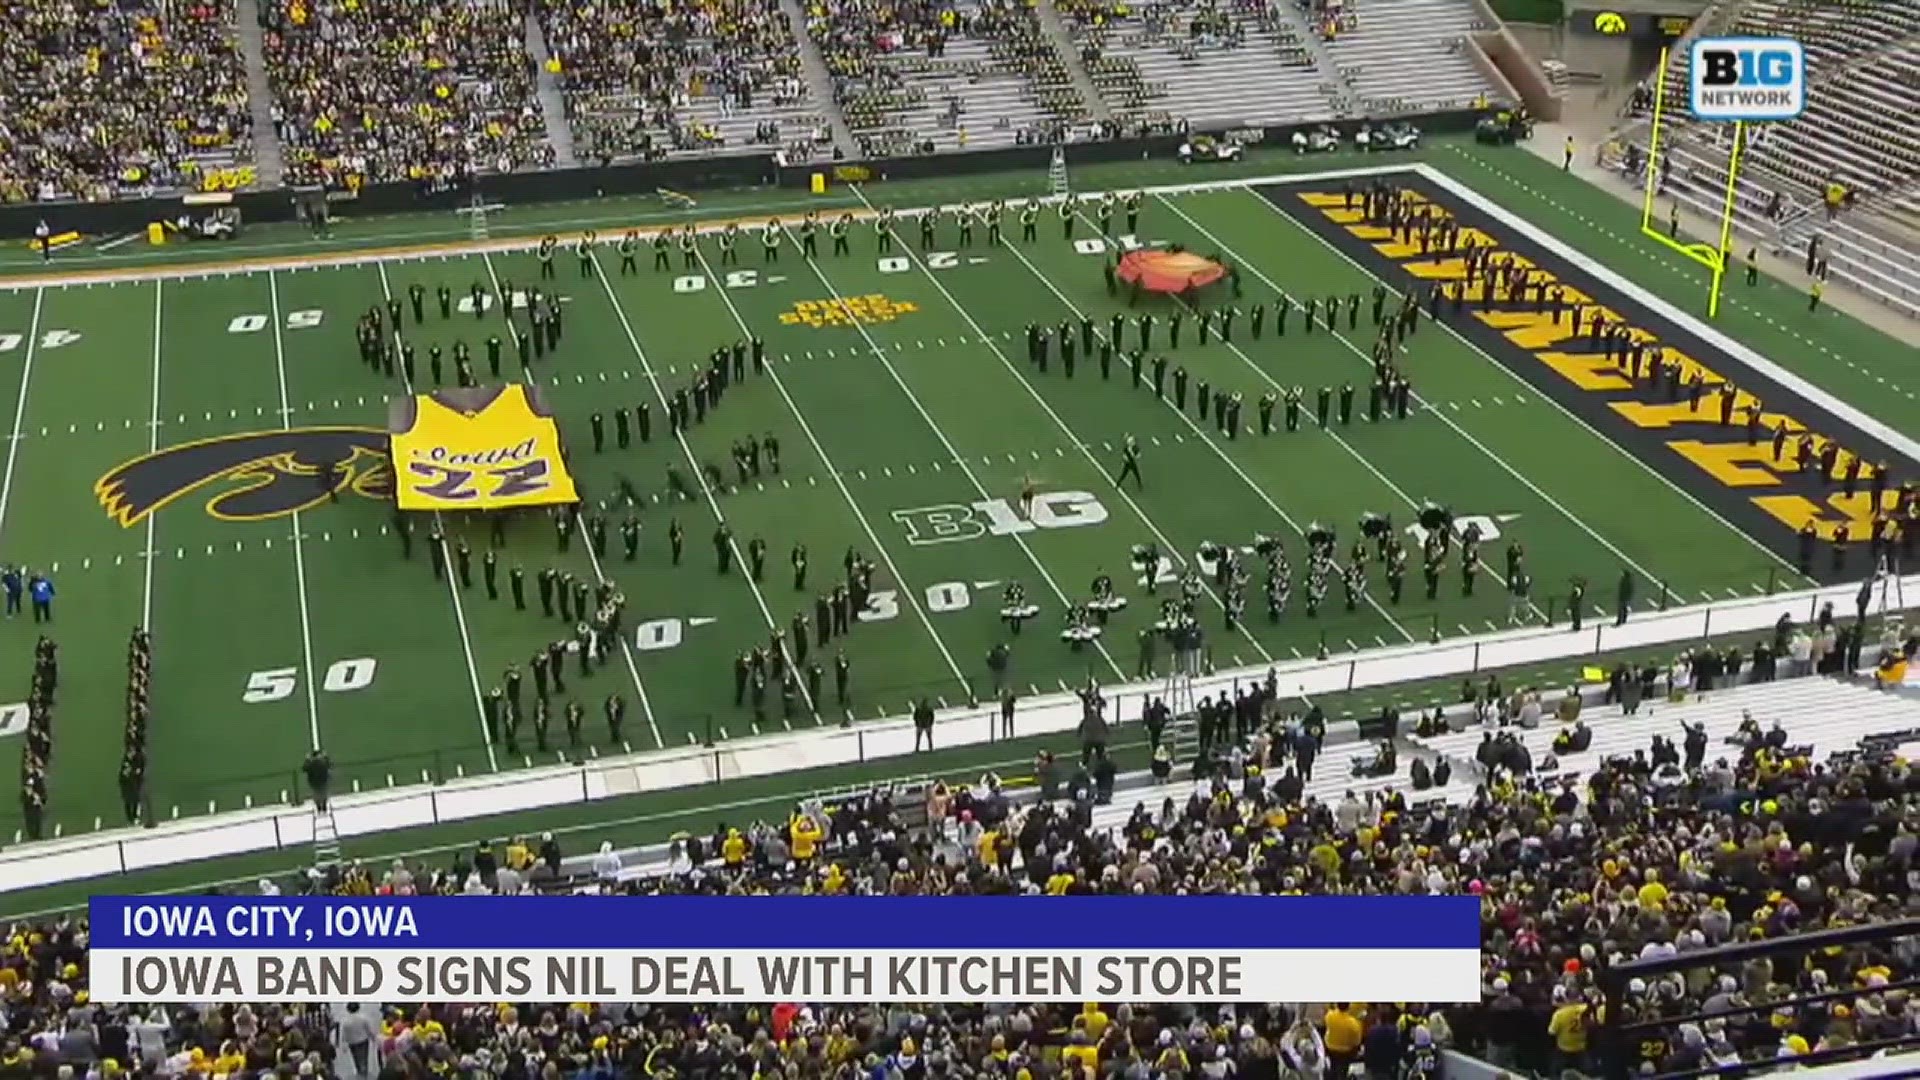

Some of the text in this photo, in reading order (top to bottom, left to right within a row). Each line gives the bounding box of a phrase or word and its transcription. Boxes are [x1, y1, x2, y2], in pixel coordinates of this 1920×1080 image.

[878, 250, 960, 274] 20
[228, 309, 324, 333] 50
[857, 581, 971, 622] 30
[242, 657, 377, 703] 50
